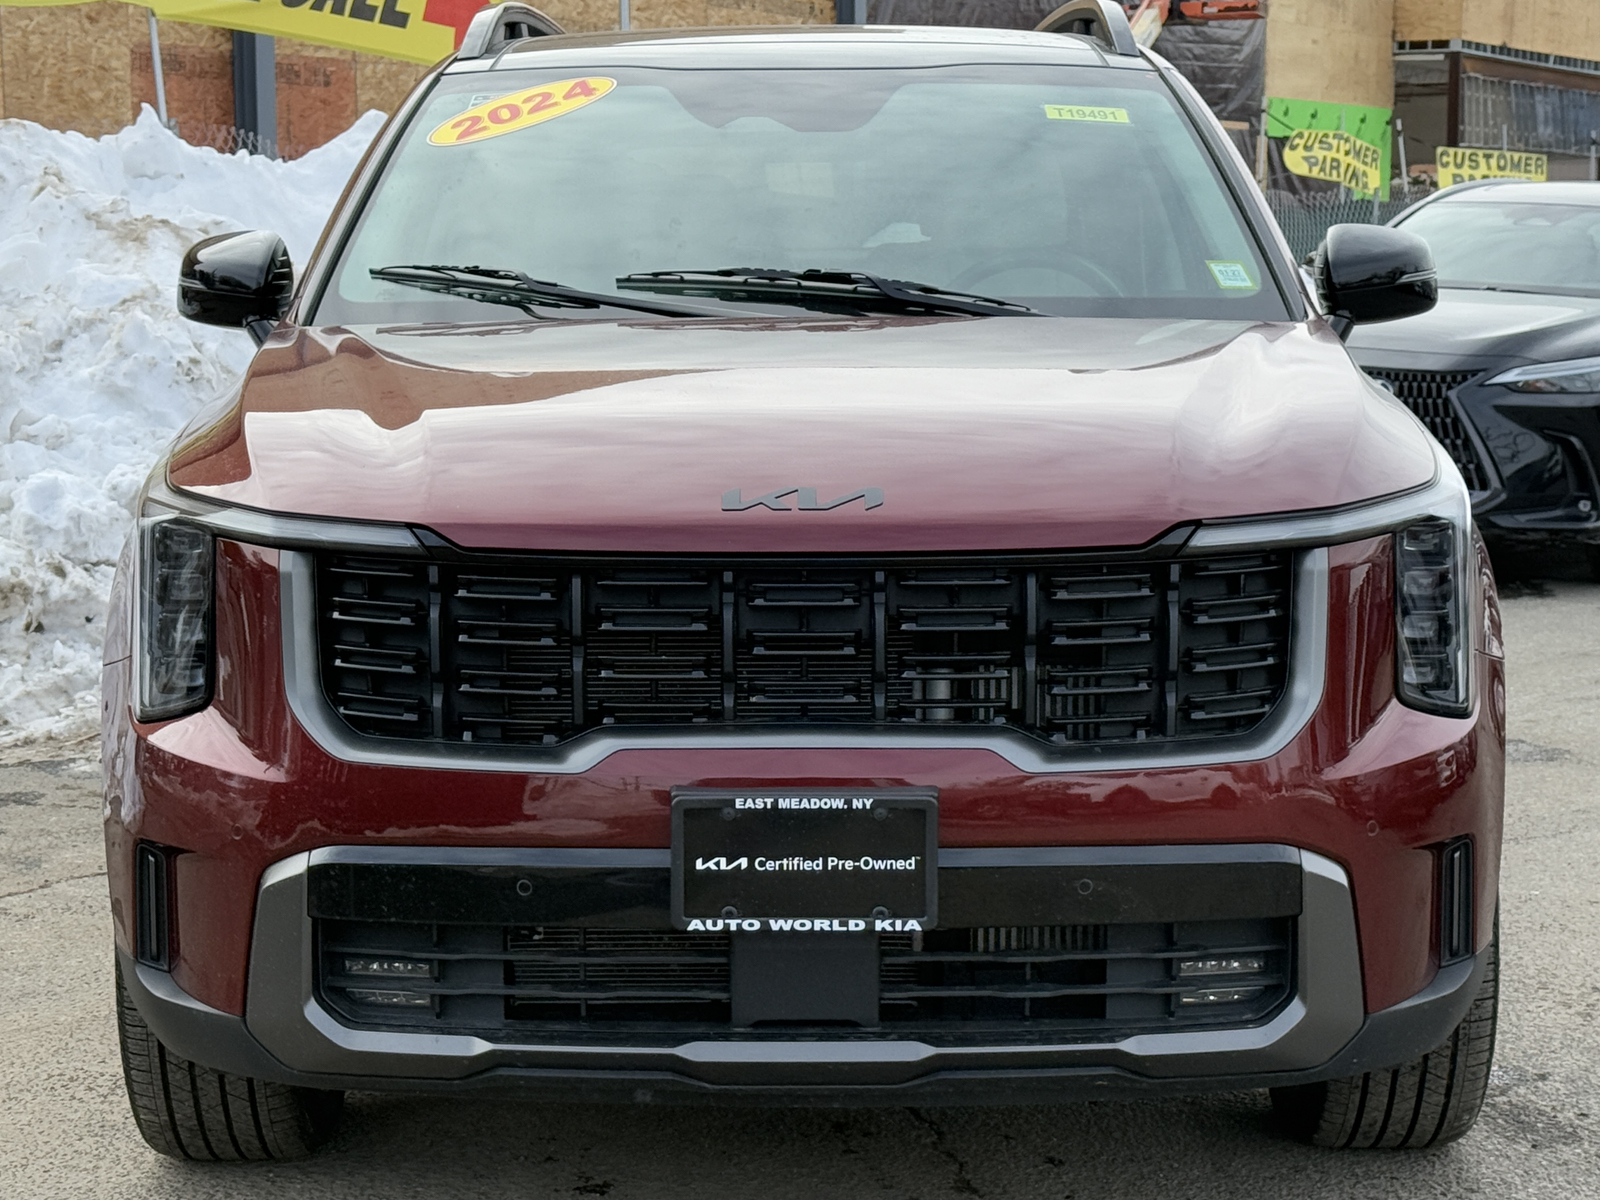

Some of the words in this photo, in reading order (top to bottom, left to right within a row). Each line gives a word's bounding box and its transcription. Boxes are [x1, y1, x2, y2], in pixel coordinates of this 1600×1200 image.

[451, 79, 599, 142] 2024
[1053, 107, 1118, 121] T19491
[1288, 131, 1380, 171] CUSTOMER
[1439, 150, 1545, 175] CUSTOMER
[735, 798, 774, 810] EAST
[852, 798, 873, 810] NY
[754, 856, 823, 871] Certified
[686, 919, 761, 931] AUTO
[769, 919, 866, 931] WORLD
[874, 919, 922, 931] KIA
